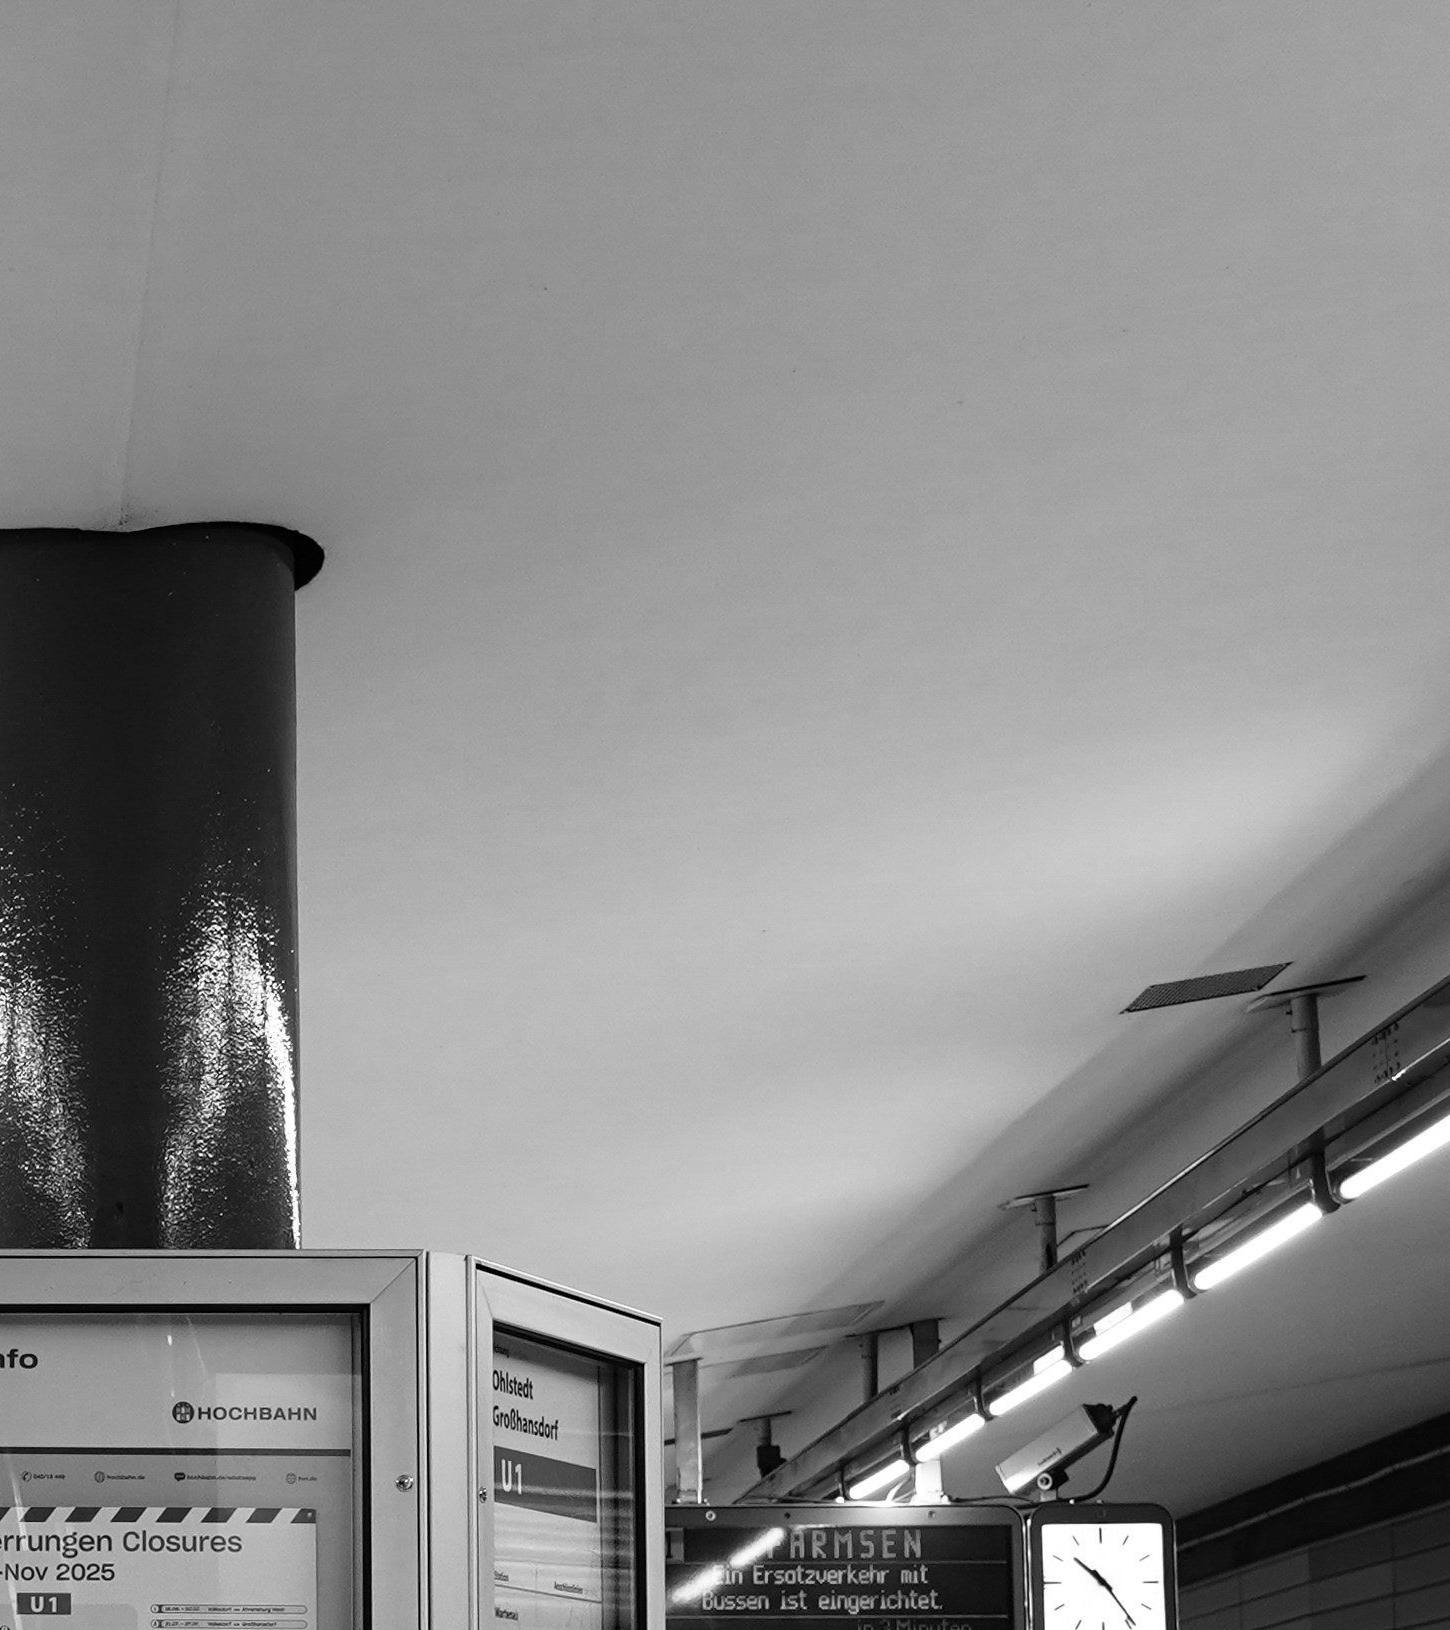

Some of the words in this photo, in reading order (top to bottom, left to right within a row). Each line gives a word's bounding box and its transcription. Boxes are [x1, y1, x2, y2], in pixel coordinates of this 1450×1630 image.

[492, 1370, 534, 1400] Ohlstedt
[198, 1406, 318, 1422] HOCHBAHN
[492, 1404, 559, 1440] Großhansdorf
[501, 1458, 522, 1495] U1
[122, 1530, 242, 1552] Closures
[56, 1563, 116, 1582] 2025
[752, 1564, 890, 1585] Ersatzverkehr
[900, 1564, 928, 1585] mit
[30, 1596, 58, 1614] U1
[702, 1590, 770, 1610] Bussen
[780, 1590, 808, 1610] ist
[818, 1589, 943, 1615] eingerichtet.
